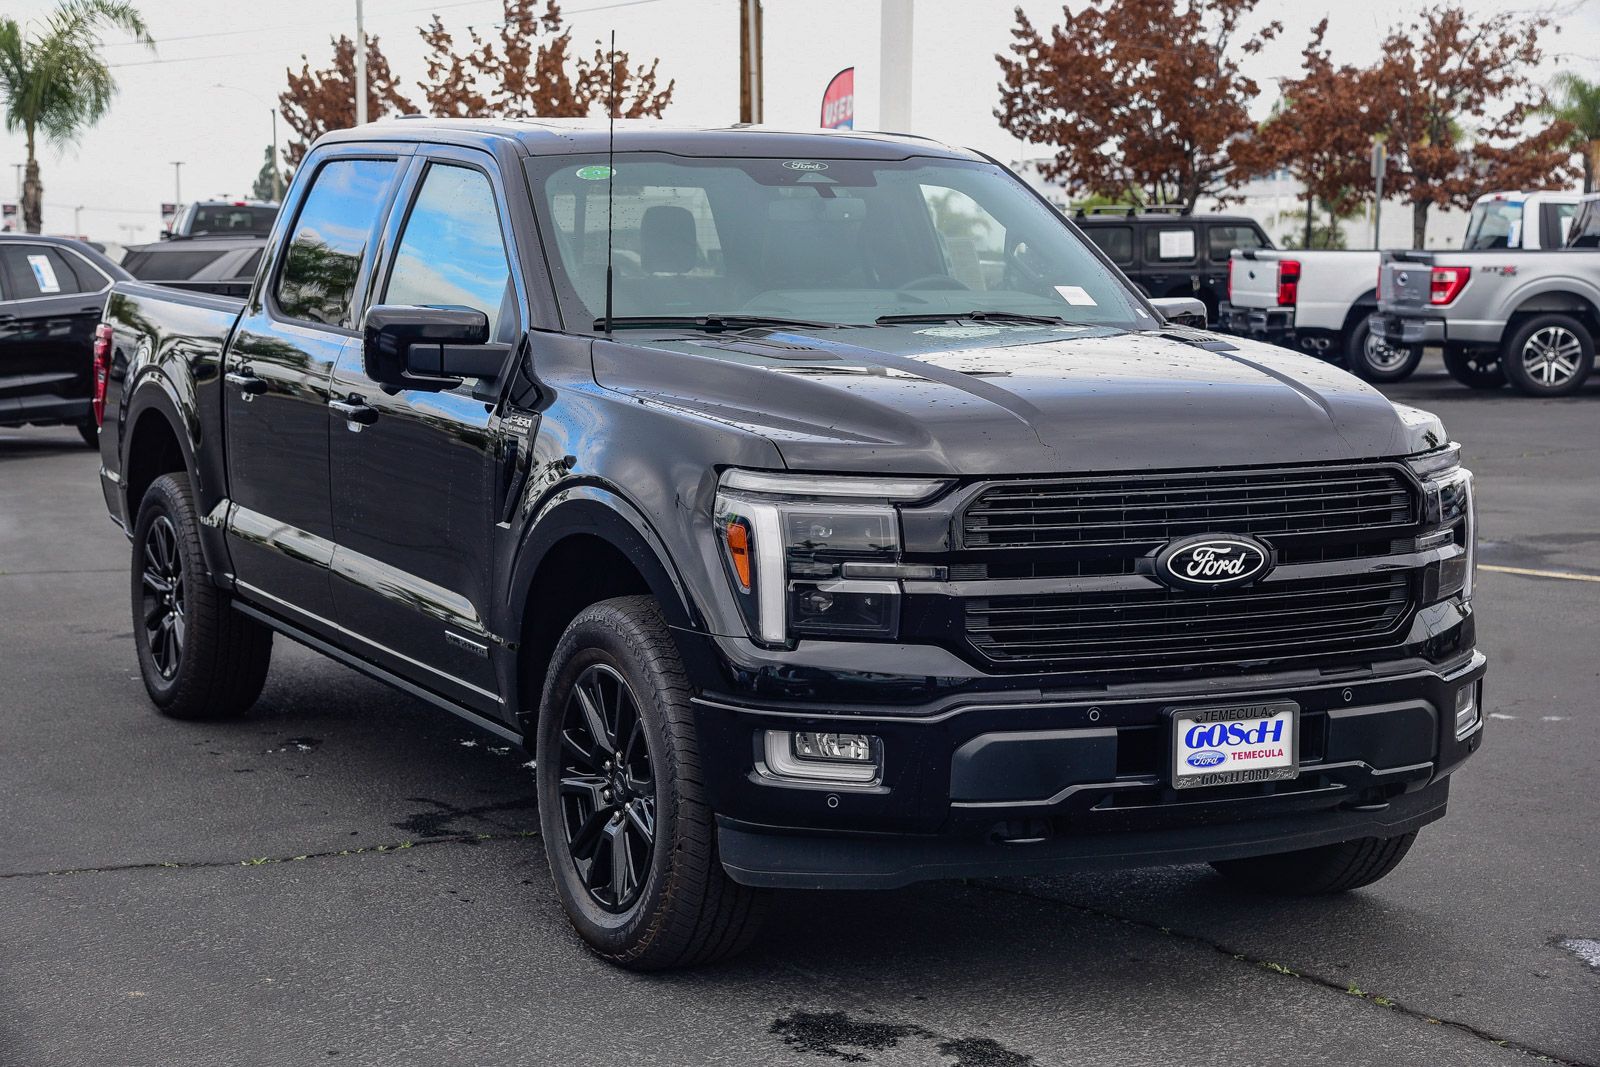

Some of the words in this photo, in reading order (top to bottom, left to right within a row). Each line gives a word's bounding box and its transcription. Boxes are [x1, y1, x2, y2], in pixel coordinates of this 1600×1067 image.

[1186, 547, 1246, 576] Ford
[1203, 707, 1269, 722] TEMECULA
[1193, 753, 1219, 766] Ford
[1231, 748, 1284, 761] TEMECULA
[1241, 769, 1269, 783] FORD
